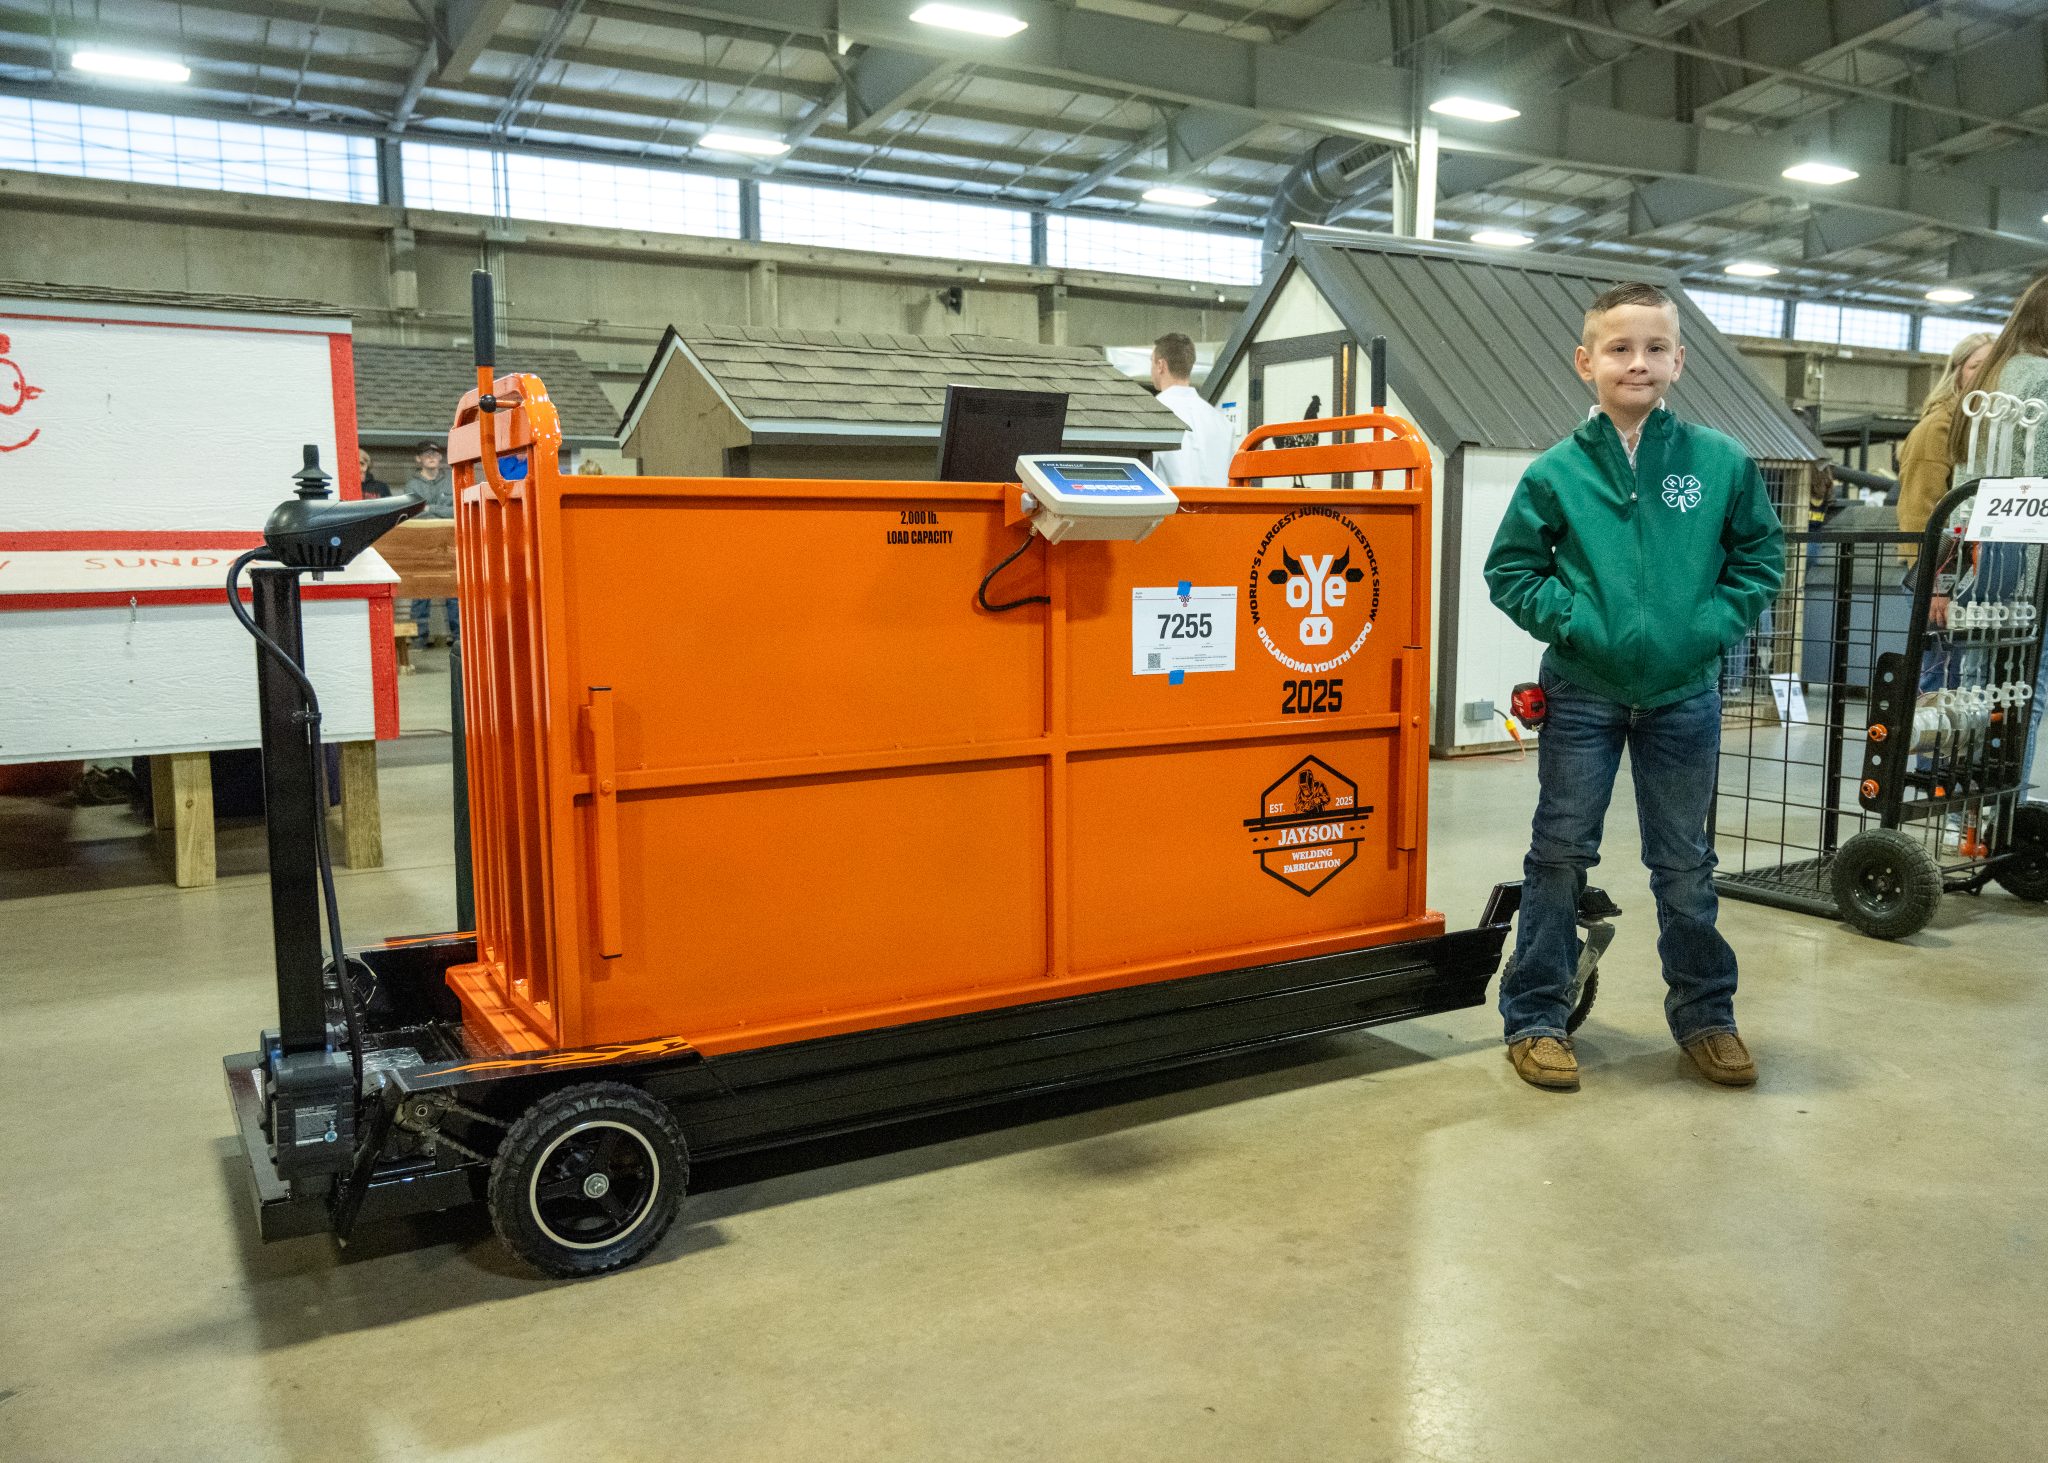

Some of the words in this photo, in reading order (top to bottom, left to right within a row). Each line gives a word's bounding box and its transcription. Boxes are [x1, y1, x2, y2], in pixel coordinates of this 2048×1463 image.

[1987, 498, 2048, 517] 24708
[900, 511, 926, 525] 2,000
[928, 511, 939, 525] lb.
[887, 530, 909, 545] LOAD
[911, 530, 953, 544] CAPACITY
[1249, 556, 1262, 625] WORLD'S
[1257, 510, 1297, 557] LARGEST
[1297, 505, 1341, 522] JUNIOR
[1340, 515, 1379, 577] LIVESTOCK
[1369, 578, 1380, 623] SHOW
[1157, 613, 1212, 639] 7255
[1257, 626, 1313, 673] OKLAHOMA
[1313, 650, 1351, 673] YOUTH
[1350, 621, 1373, 655] EXPO
[1282, 679, 1343, 714] 2025
[1269, 803, 1285, 813] EST.
[1335, 796, 1353, 806] 2025
[1278, 823, 1344, 846] JAYSON
[1292, 848, 1333, 861] WELDING
[1283, 859, 1341, 874] FABRICATION
